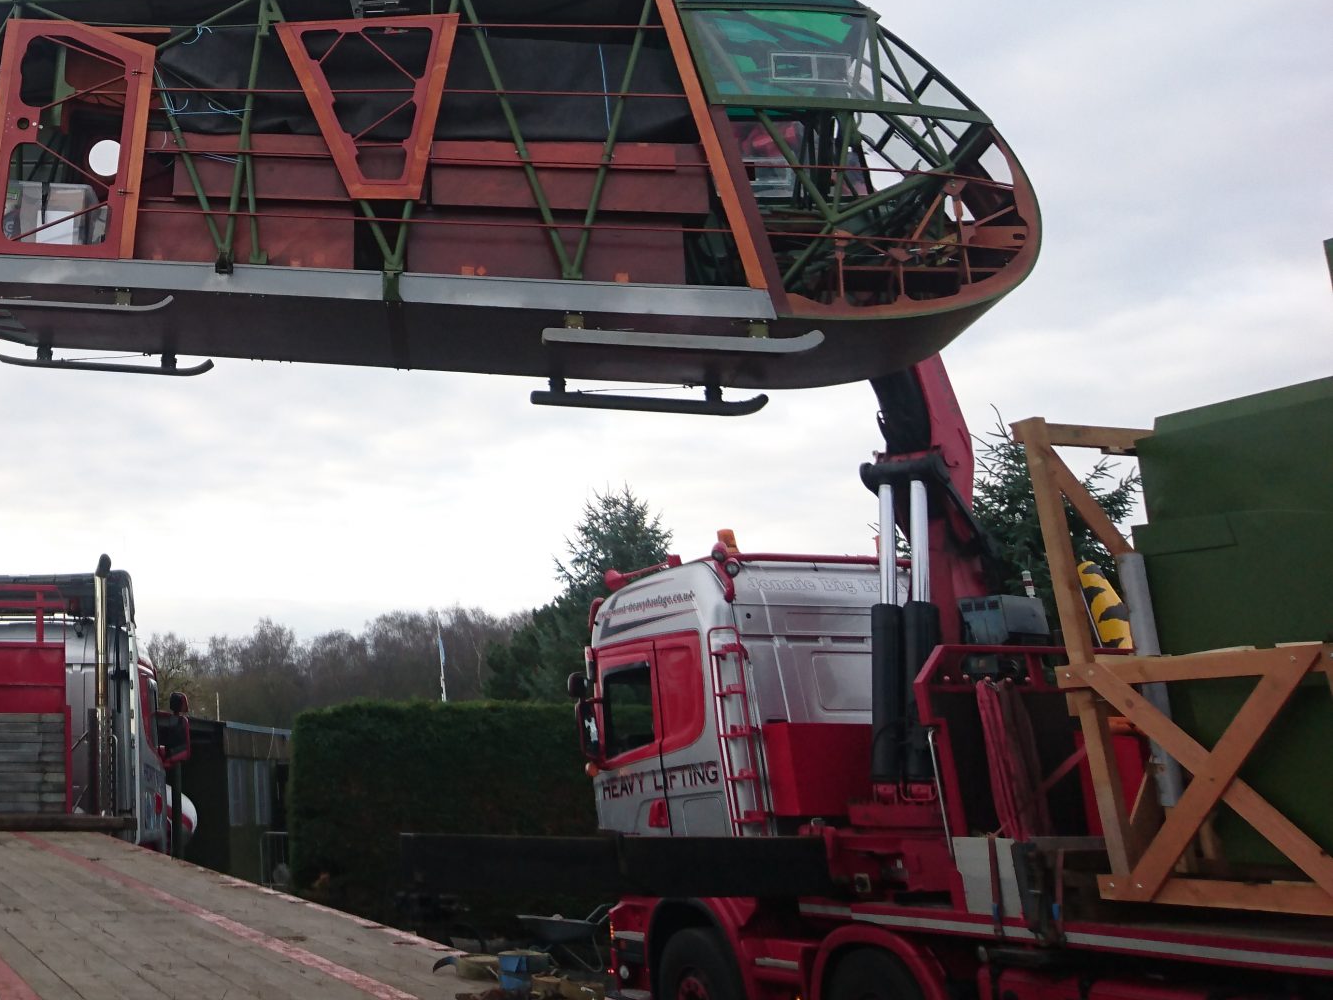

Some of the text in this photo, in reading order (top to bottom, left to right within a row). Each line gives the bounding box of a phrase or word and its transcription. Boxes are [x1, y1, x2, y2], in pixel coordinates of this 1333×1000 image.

[819, 577, 857, 594] Big
[602, 761, 719, 800] HEAVY LIFTING
